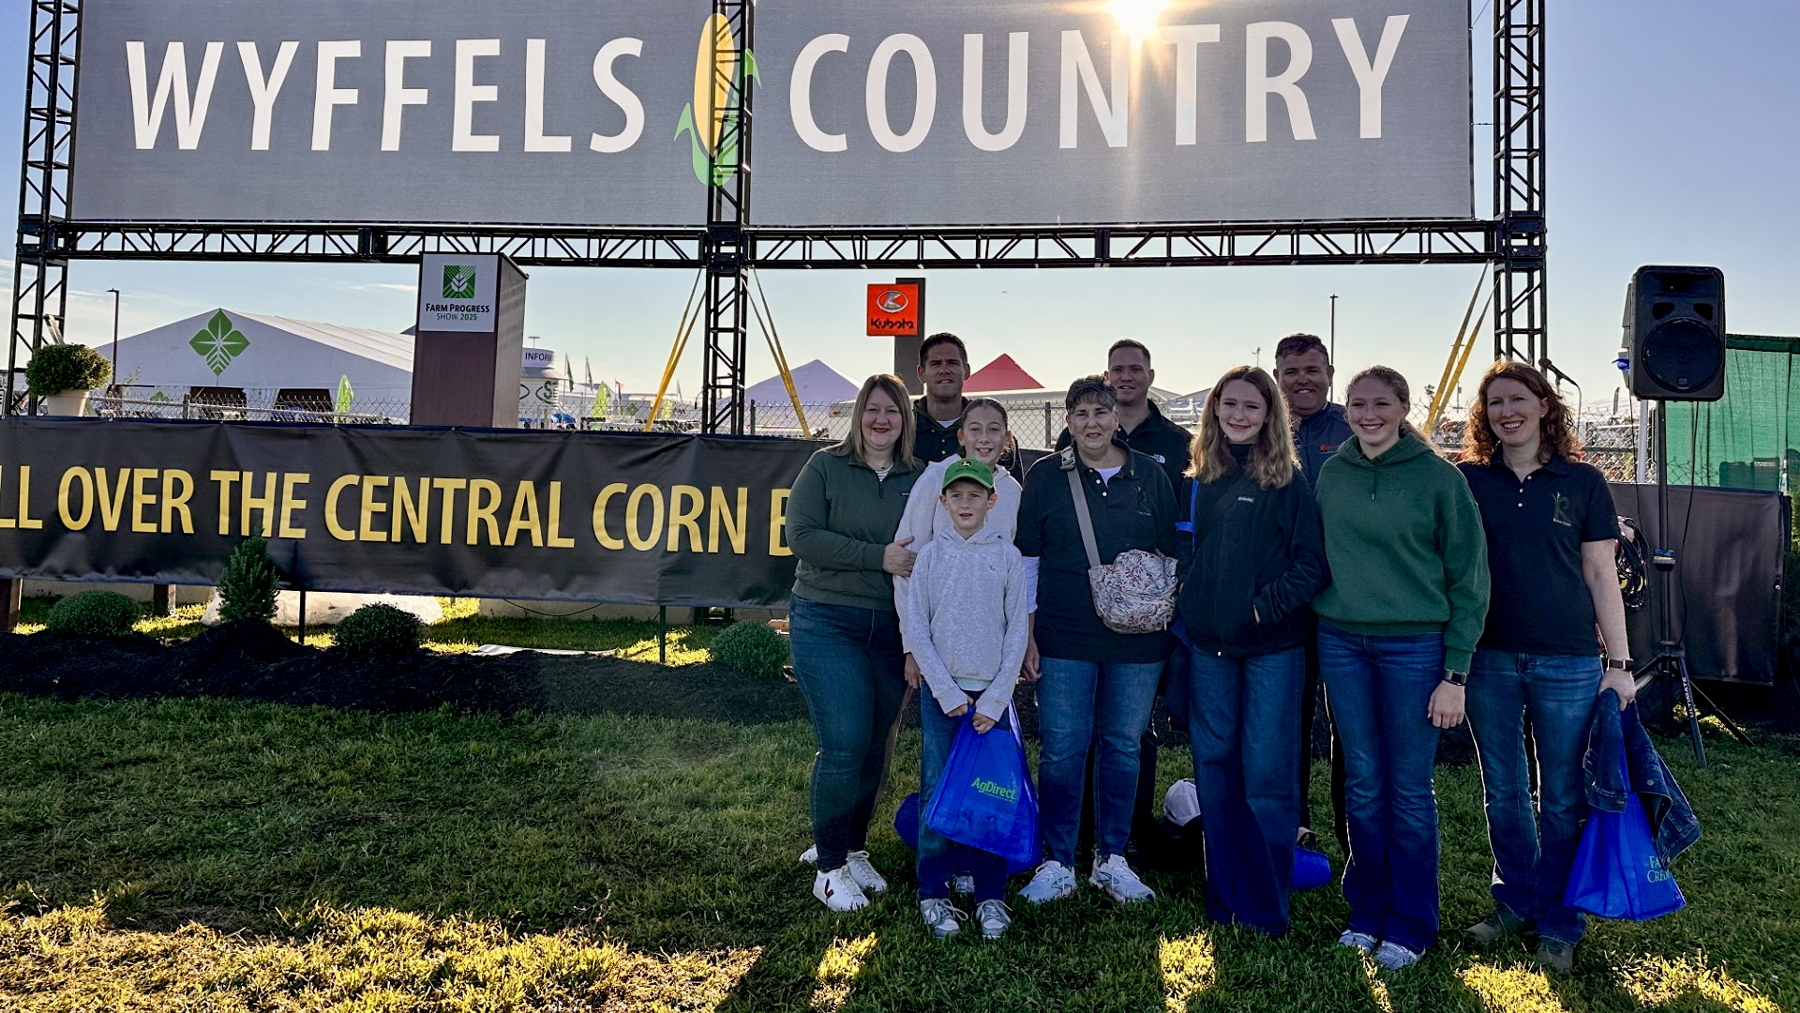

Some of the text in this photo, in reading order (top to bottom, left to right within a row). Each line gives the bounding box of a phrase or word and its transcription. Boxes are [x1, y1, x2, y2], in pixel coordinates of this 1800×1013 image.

[125, 14, 1411, 154] WYFFELS COUNTRY
[425, 303, 490, 313] FARM PROGRESS
[436, 312, 478, 321] SHOW 2025
[871, 318, 914, 329] Kubota
[57, 465, 195, 535] OVER
[210, 470, 310, 539] THE
[324, 474, 576, 548] CENTRAL
[592, 482, 748, 555] CORN
[1681, 676, 1694, 718] ULTIMATE
[971, 777, 1017, 800] AgDirect
